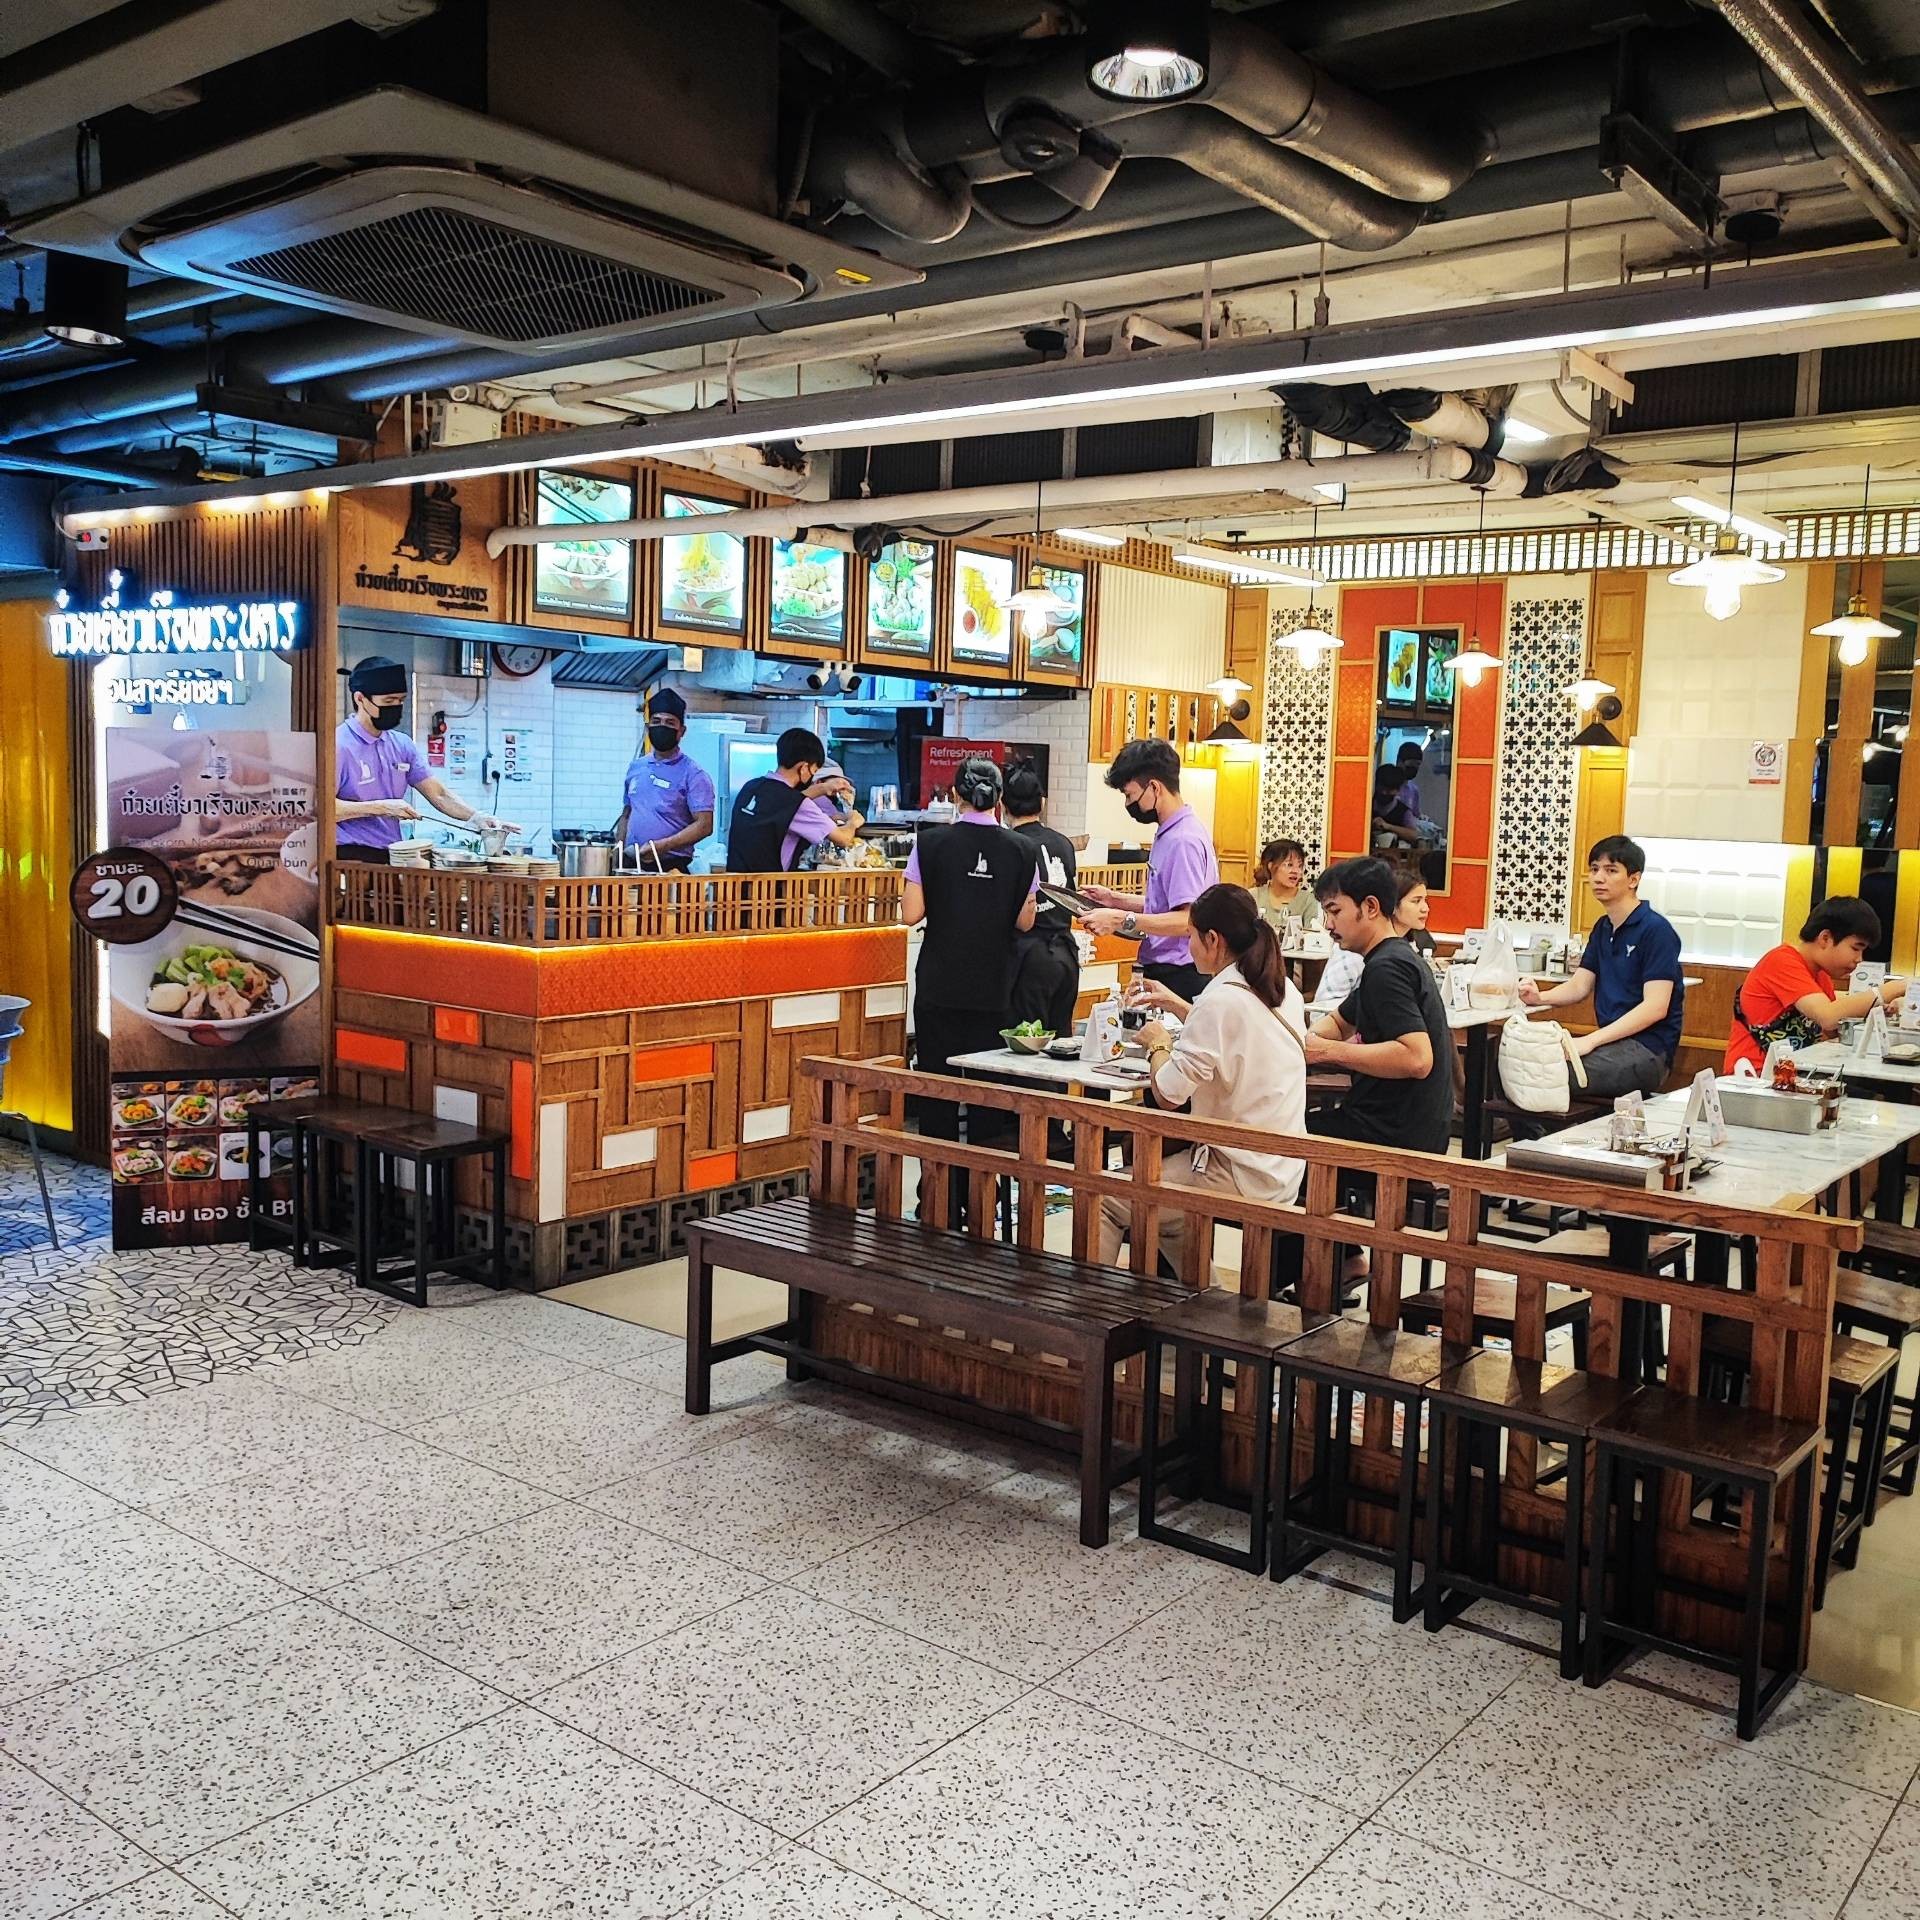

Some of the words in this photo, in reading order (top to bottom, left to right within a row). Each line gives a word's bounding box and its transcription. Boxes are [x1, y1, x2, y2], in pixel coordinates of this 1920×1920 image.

[929, 746, 994, 759] Refreshment
[95, 863, 144, 876] ชามละ
[88, 875, 160, 919] 20
[140, 1206, 186, 1225] สีลม
[193, 1206, 229, 1221] เอจ
[236, 1196, 264, 1220] ชั้
[272, 1199, 294, 1216] B1
